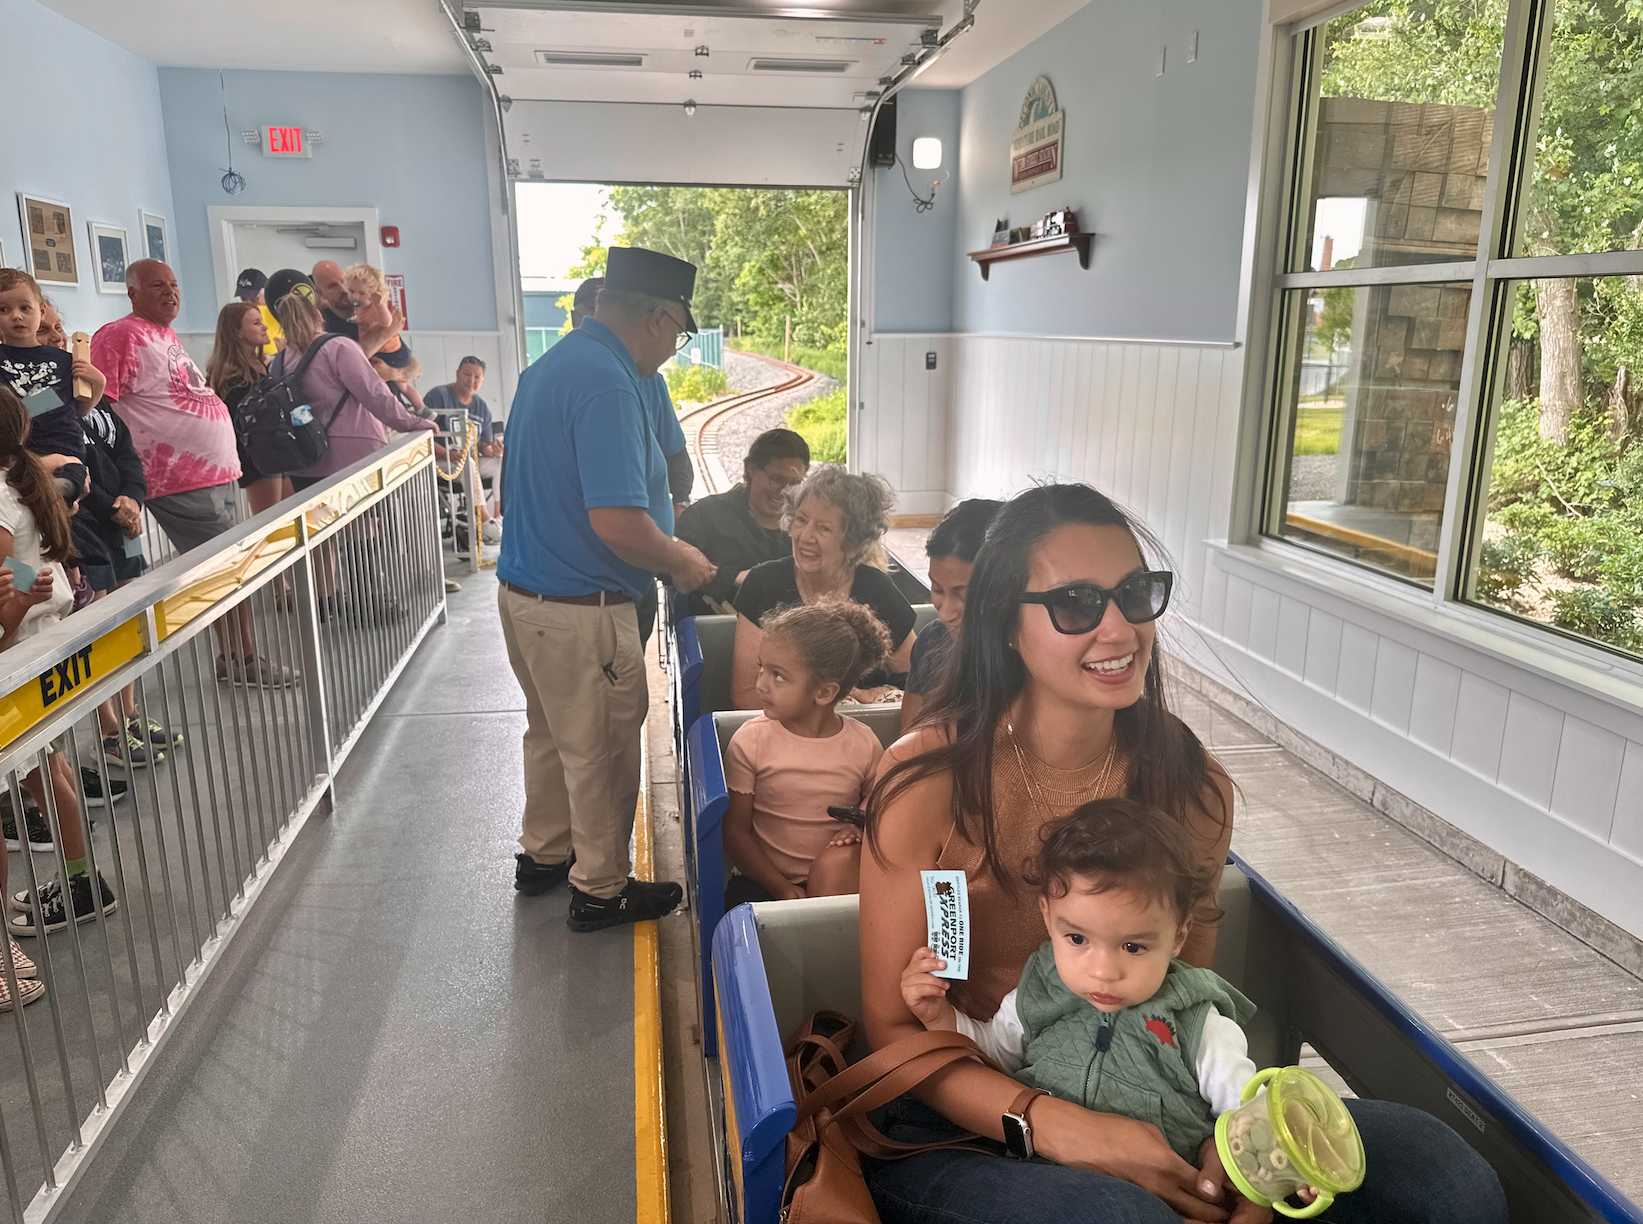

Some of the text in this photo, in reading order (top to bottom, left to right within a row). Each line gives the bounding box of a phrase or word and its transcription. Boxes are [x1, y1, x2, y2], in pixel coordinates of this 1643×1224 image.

[268, 126, 302, 153] EXIT
[387, 279, 402, 287] FIRE
[39, 643, 93, 709] EXIT
[948, 885, 957, 961] GREENPORT
[1464, 1105, 1480, 1123] SEAT
